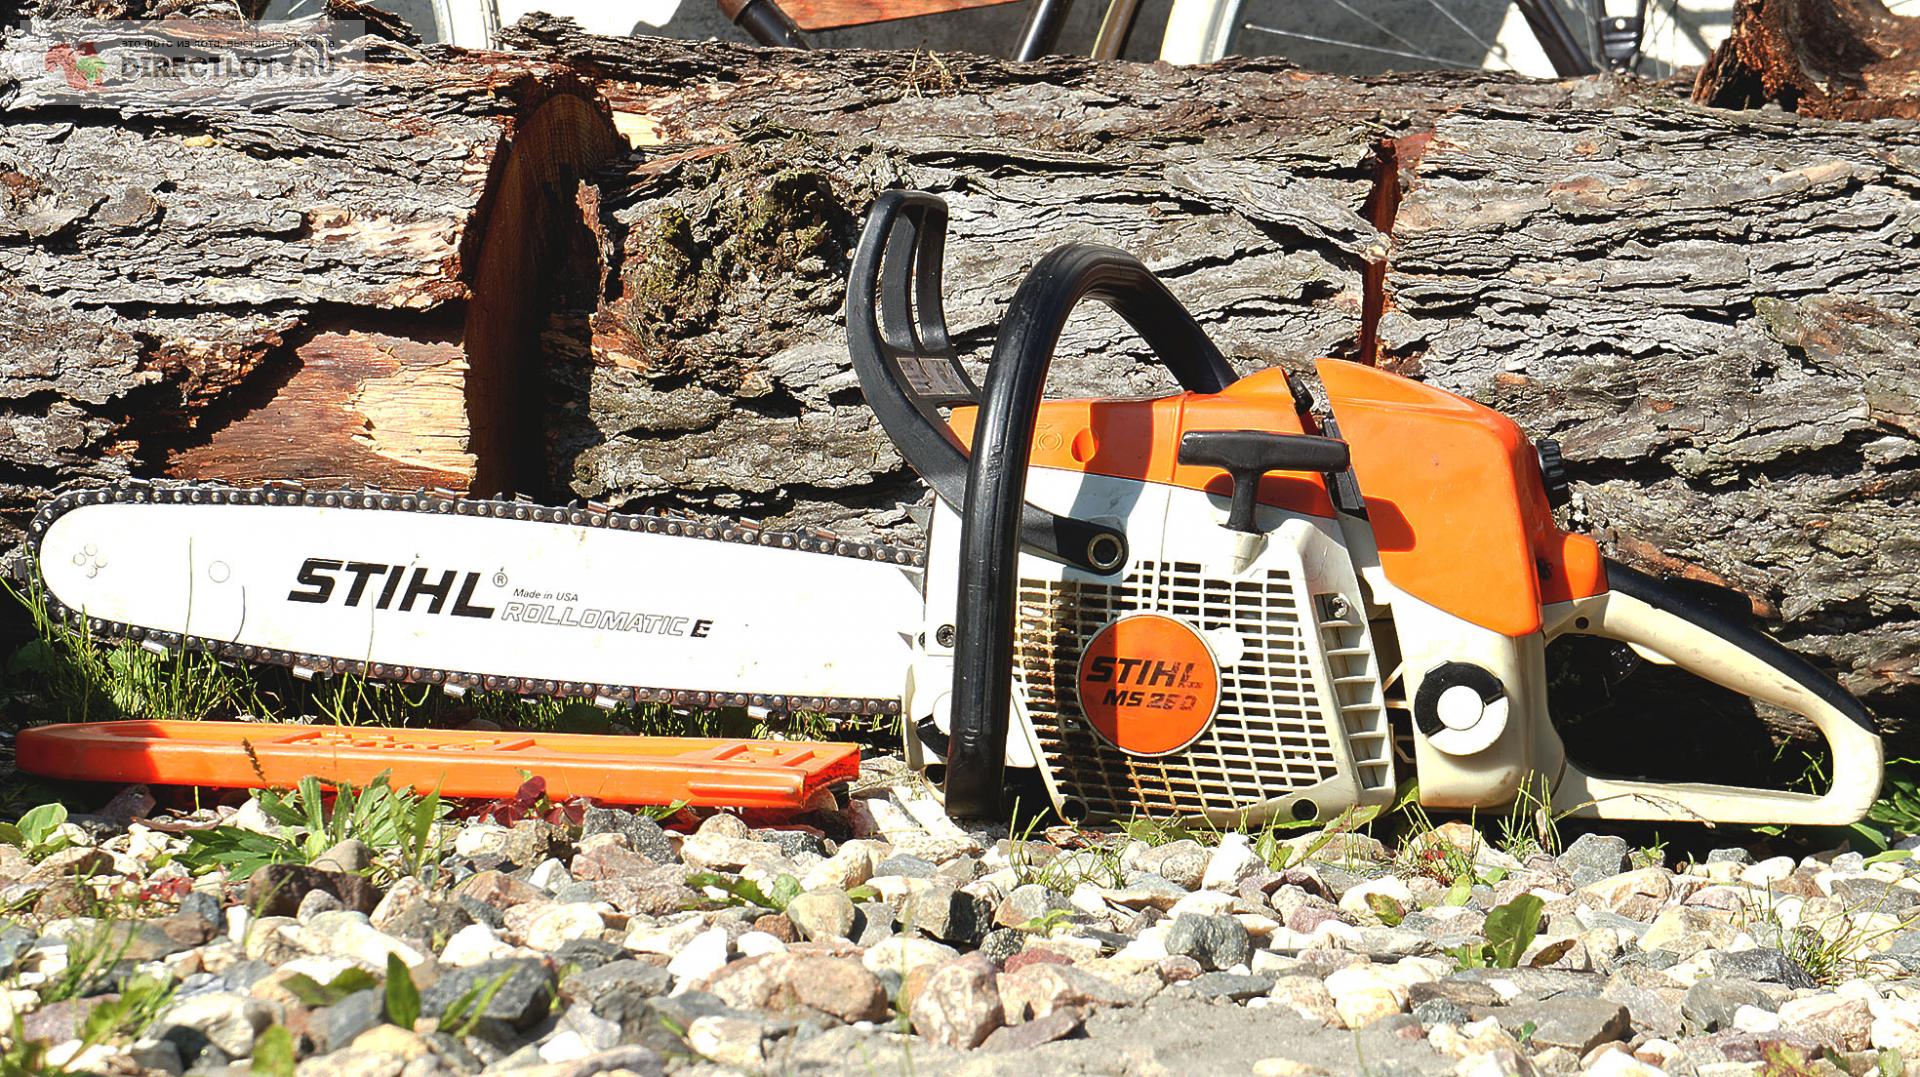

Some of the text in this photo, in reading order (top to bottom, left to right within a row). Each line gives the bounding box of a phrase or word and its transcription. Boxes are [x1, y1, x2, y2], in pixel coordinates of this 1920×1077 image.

[287, 557, 496, 619] STIHL
[513, 588, 580, 602] Made in USA
[501, 601, 714, 638] ROLLOMATIC E
[1086, 656, 1203, 689] STIHL
[1103, 688, 1146, 708] MS
